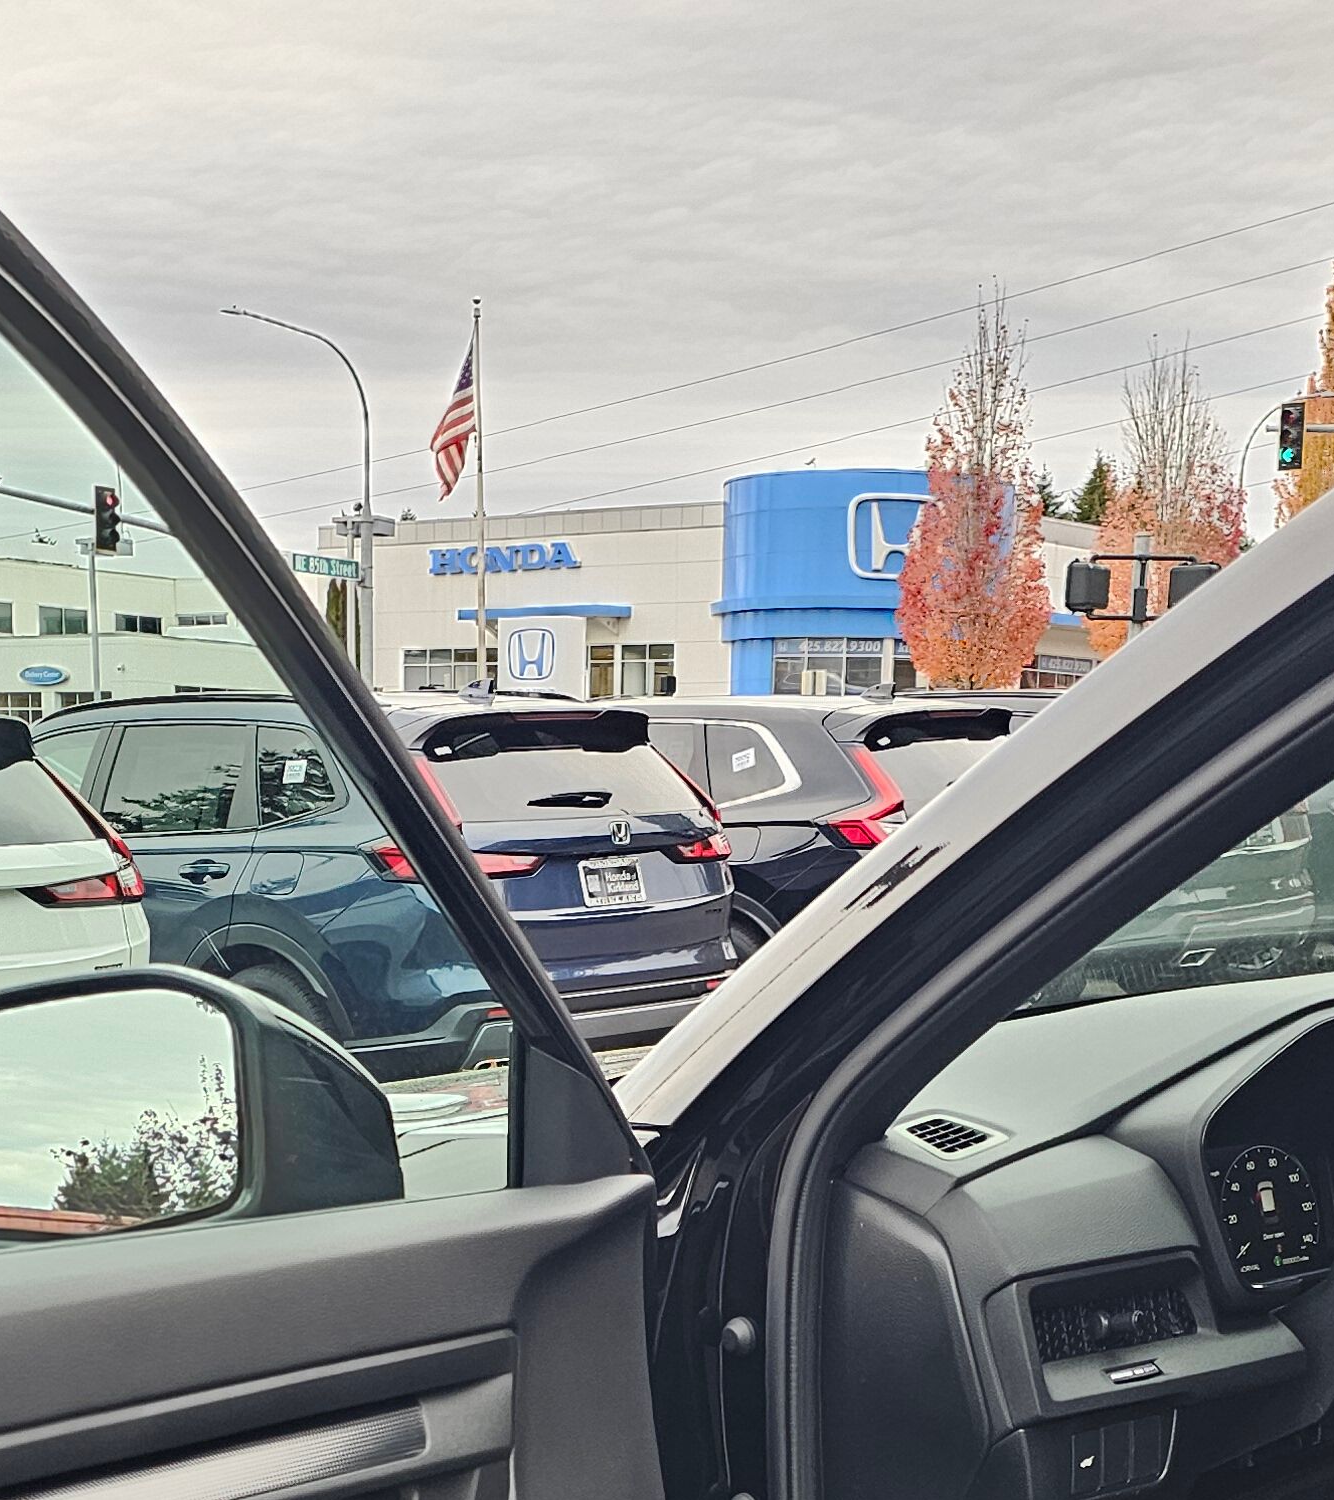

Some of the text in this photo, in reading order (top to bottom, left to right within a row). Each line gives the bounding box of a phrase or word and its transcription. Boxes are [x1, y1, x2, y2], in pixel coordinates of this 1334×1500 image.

[428, 543, 581, 576] HONDA
[295, 555, 357, 577] NE 85th Street
[605, 870, 631, 882] Honda
[1246, 1161, 1255, 1171] 60
[1268, 1158, 1278, 1168] 80
[1288, 1173, 1300, 1182] 100
[1230, 1182, 1240, 1192] 40
[1301, 1202, 1313, 1211] 120
[1228, 1214, 1238, 1224] 20
[1302, 1233, 1314, 1242] 140
[1240, 1264, 1260, 1273] ORMAL
